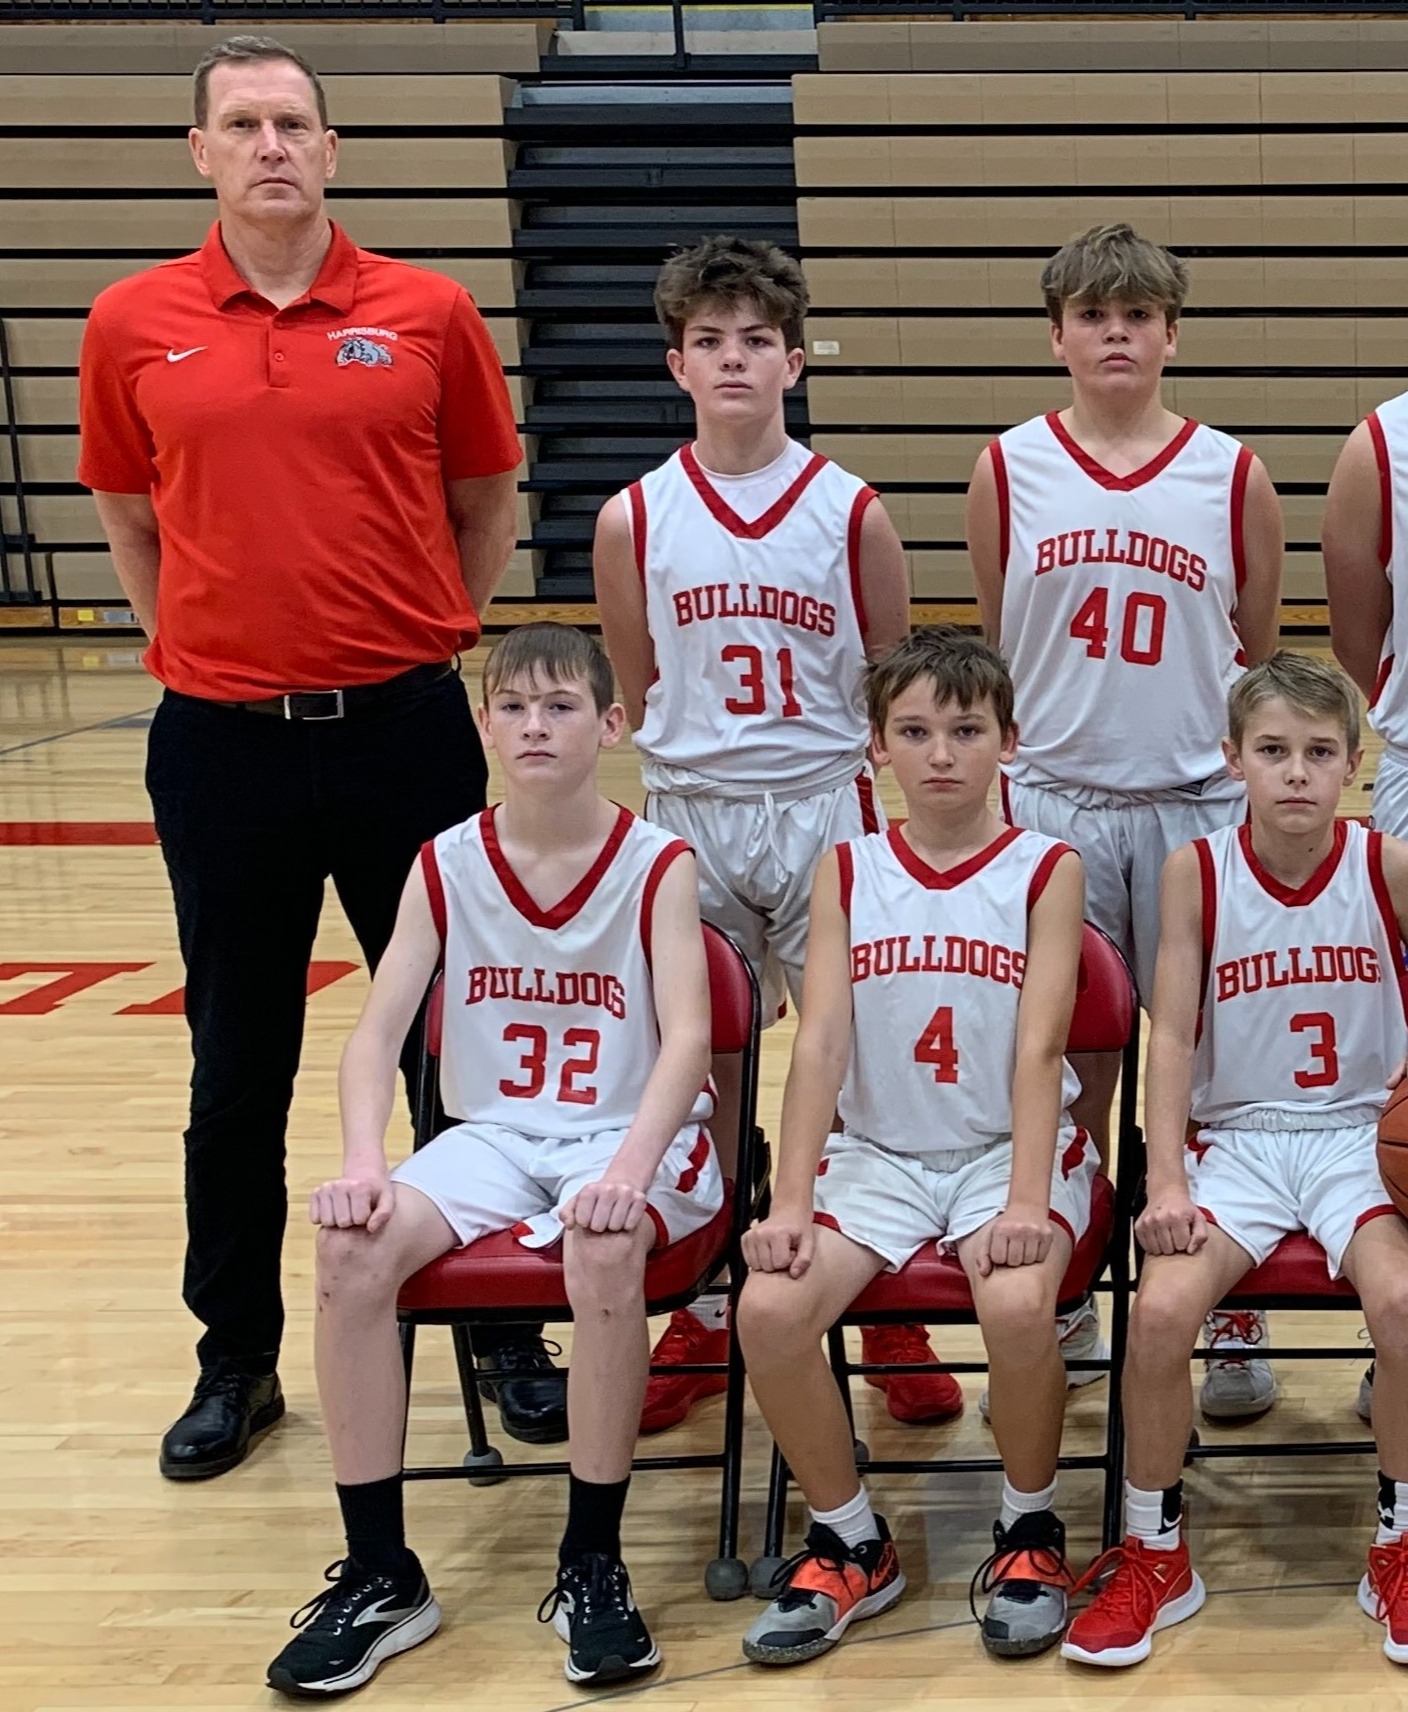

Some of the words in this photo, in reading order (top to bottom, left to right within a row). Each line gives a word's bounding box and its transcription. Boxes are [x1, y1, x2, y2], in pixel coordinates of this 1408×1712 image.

[1035, 529, 1207, 593] BULLDOGS
[673, 584, 835, 637] BULLDOGS
[1070, 587, 1167, 666] 40
[721, 644, 802, 718] 31
[851, 935, 1028, 991] BULLDOGS
[1216, 946, 1383, 1002] BULLDOG
[499, 1023, 600, 1105] 32
[914, 1006, 958, 1084] 4
[1290, 1012, 1339, 1089] 3
